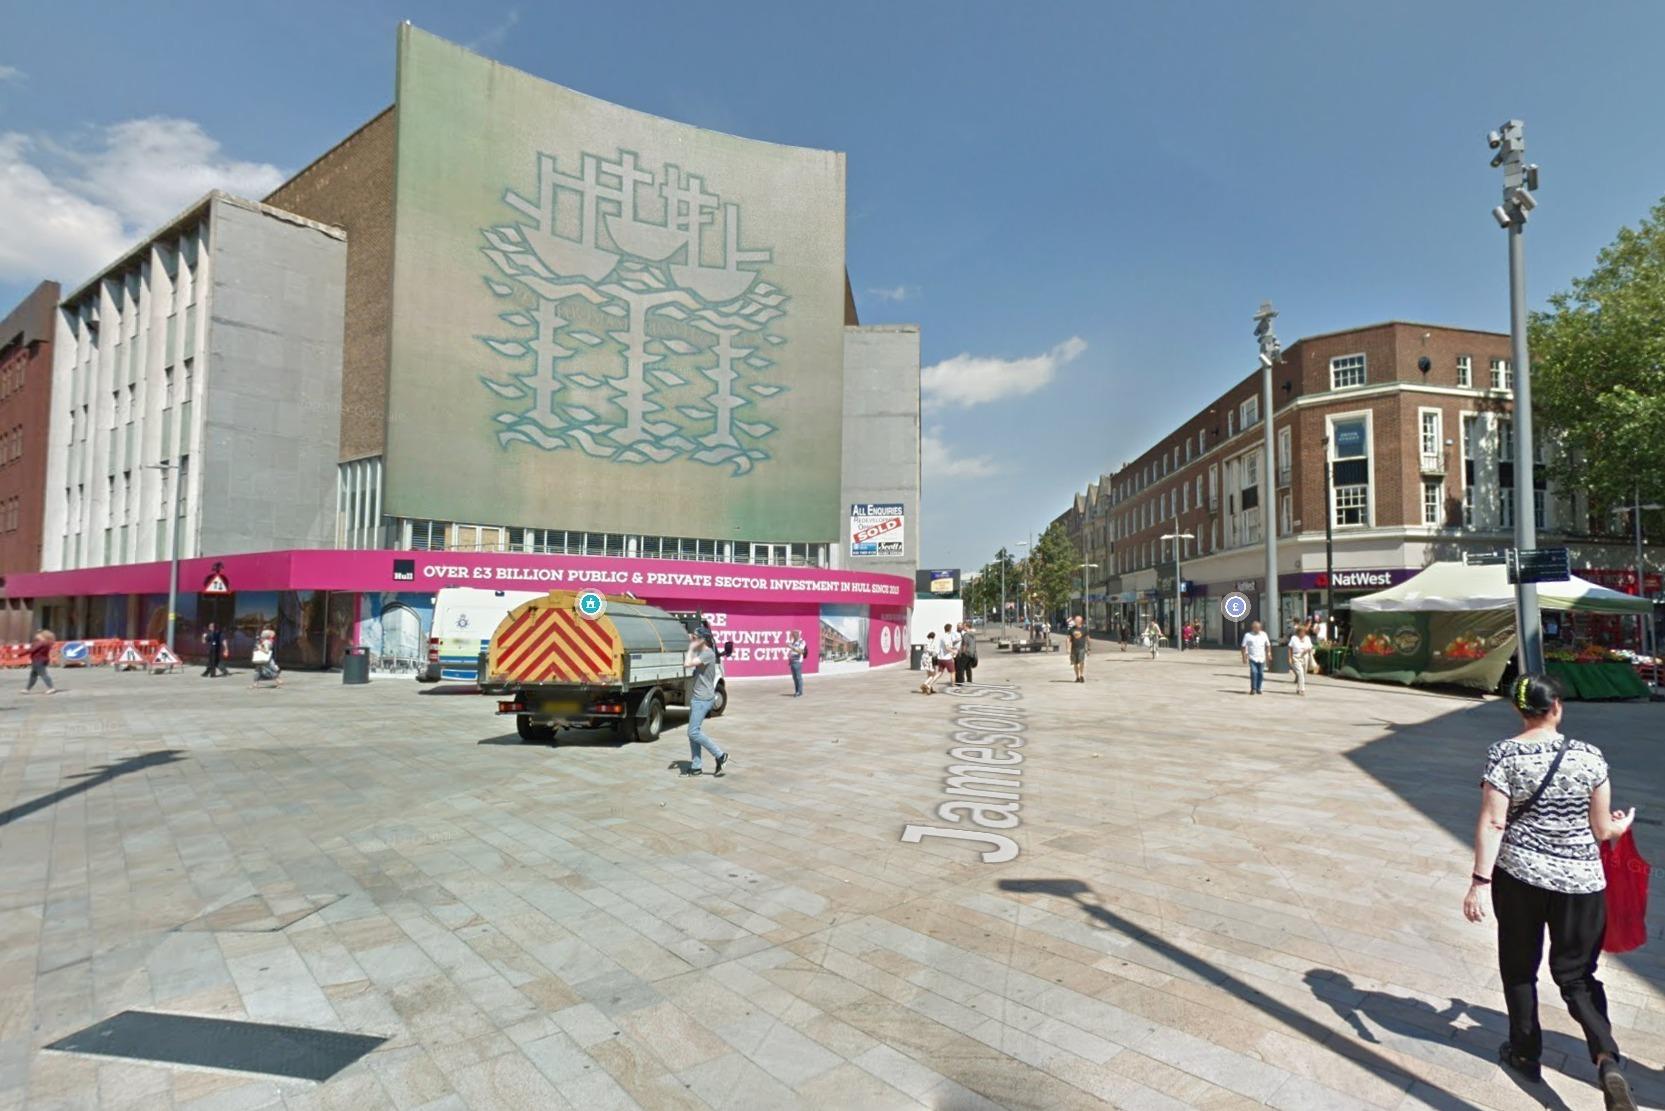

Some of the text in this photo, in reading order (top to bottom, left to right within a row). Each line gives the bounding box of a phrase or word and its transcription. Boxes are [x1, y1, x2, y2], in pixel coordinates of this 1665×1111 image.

[853, 504, 902, 515] ALL ENQUIRIES
[858, 519, 898, 541] SOLD
[394, 572, 413, 580] Hull
[423, 565, 470, 578] OVER
[472, 567, 492, 579] £3
[495, 568, 564, 581] BILLION
[567, 570, 628, 583] PUBLIC
[631, 572, 644, 584] &
[646, 573, 712, 587] PRIVATE
[714, 576, 768, 590] SECTOR
[769, 579, 839, 592] INVESTMENT
[840, 582, 850, 592] IN
[851, 582, 871, 593] HULL
[871, 583, 889, 594] SINCE
[1332, 571, 1392, 586] NatWest
[702, 613, 727, 626] RE
[711, 630, 782, 644] RTUNITY
[754, 648, 790, 661] CITY
